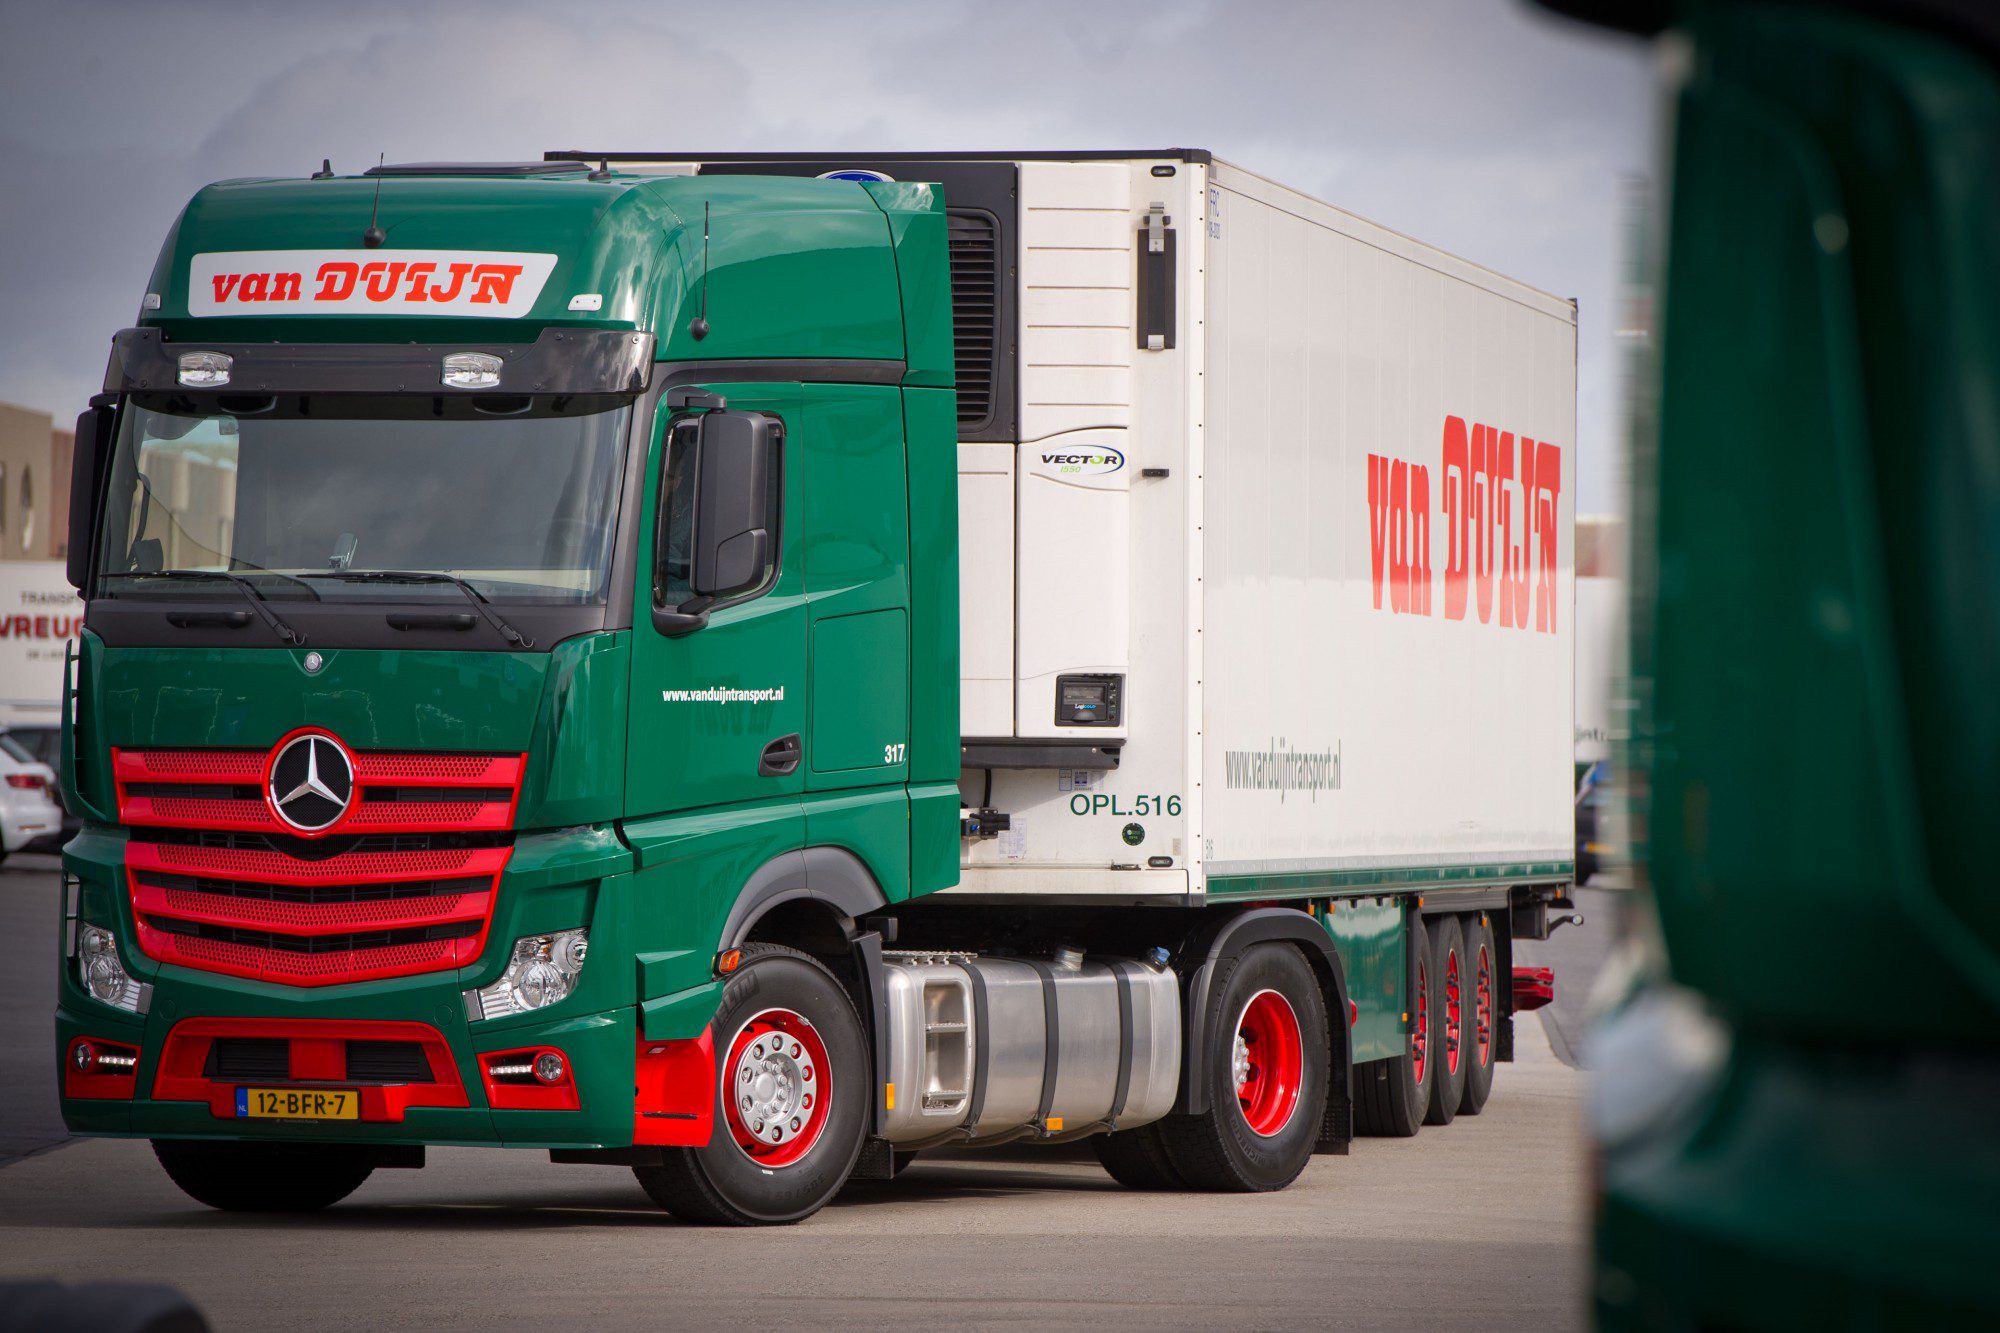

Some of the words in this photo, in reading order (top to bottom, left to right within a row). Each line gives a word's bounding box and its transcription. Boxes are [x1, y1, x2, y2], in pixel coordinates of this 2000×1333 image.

[212, 272, 302, 303] van
[314, 262, 523, 304] DUIJN
[1042, 455, 1118, 464] VECTOR
[1368, 453, 1431, 616] van
[1442, 415, 1561, 634] DUIJN
[662, 686, 784, 705] www.vanduijntransport.nl
[885, 744, 905, 763] 317
[1225, 736, 1341, 804] www.vanduijntransport.nl
[1070, 794, 1182, 817] OPL.516
[258, 1093, 346, 1115] 12-BFR-7
